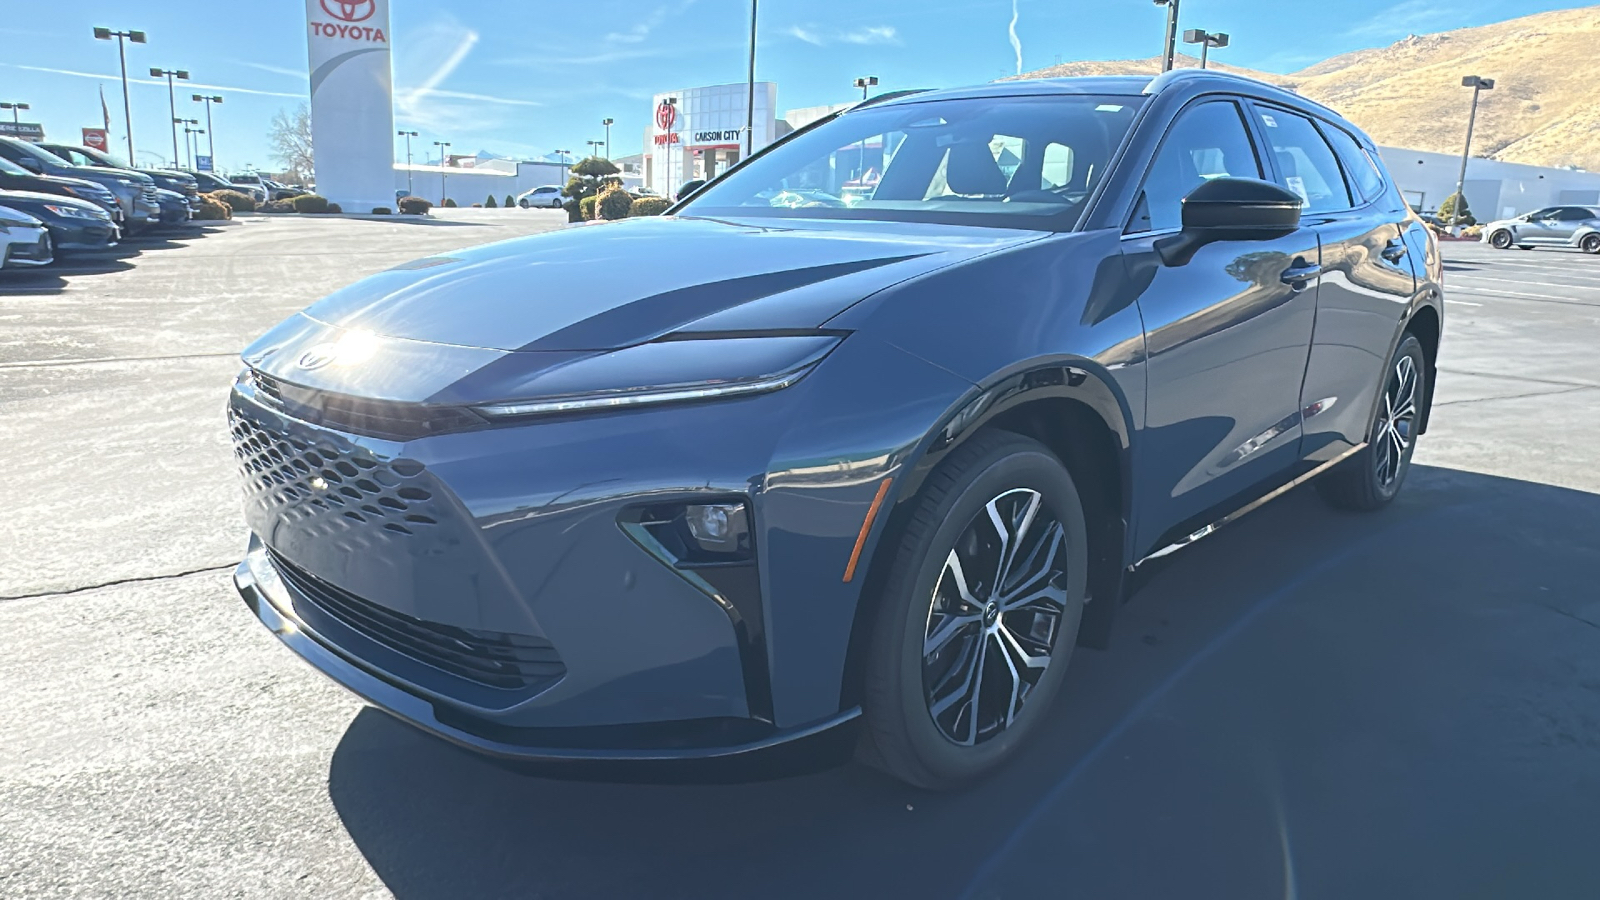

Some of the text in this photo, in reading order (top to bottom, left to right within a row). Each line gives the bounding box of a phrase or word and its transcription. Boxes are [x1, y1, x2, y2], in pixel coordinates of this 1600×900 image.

[310, 22, 386, 42] TOYOTA
[694, 130, 741, 142] CARSON CITY
